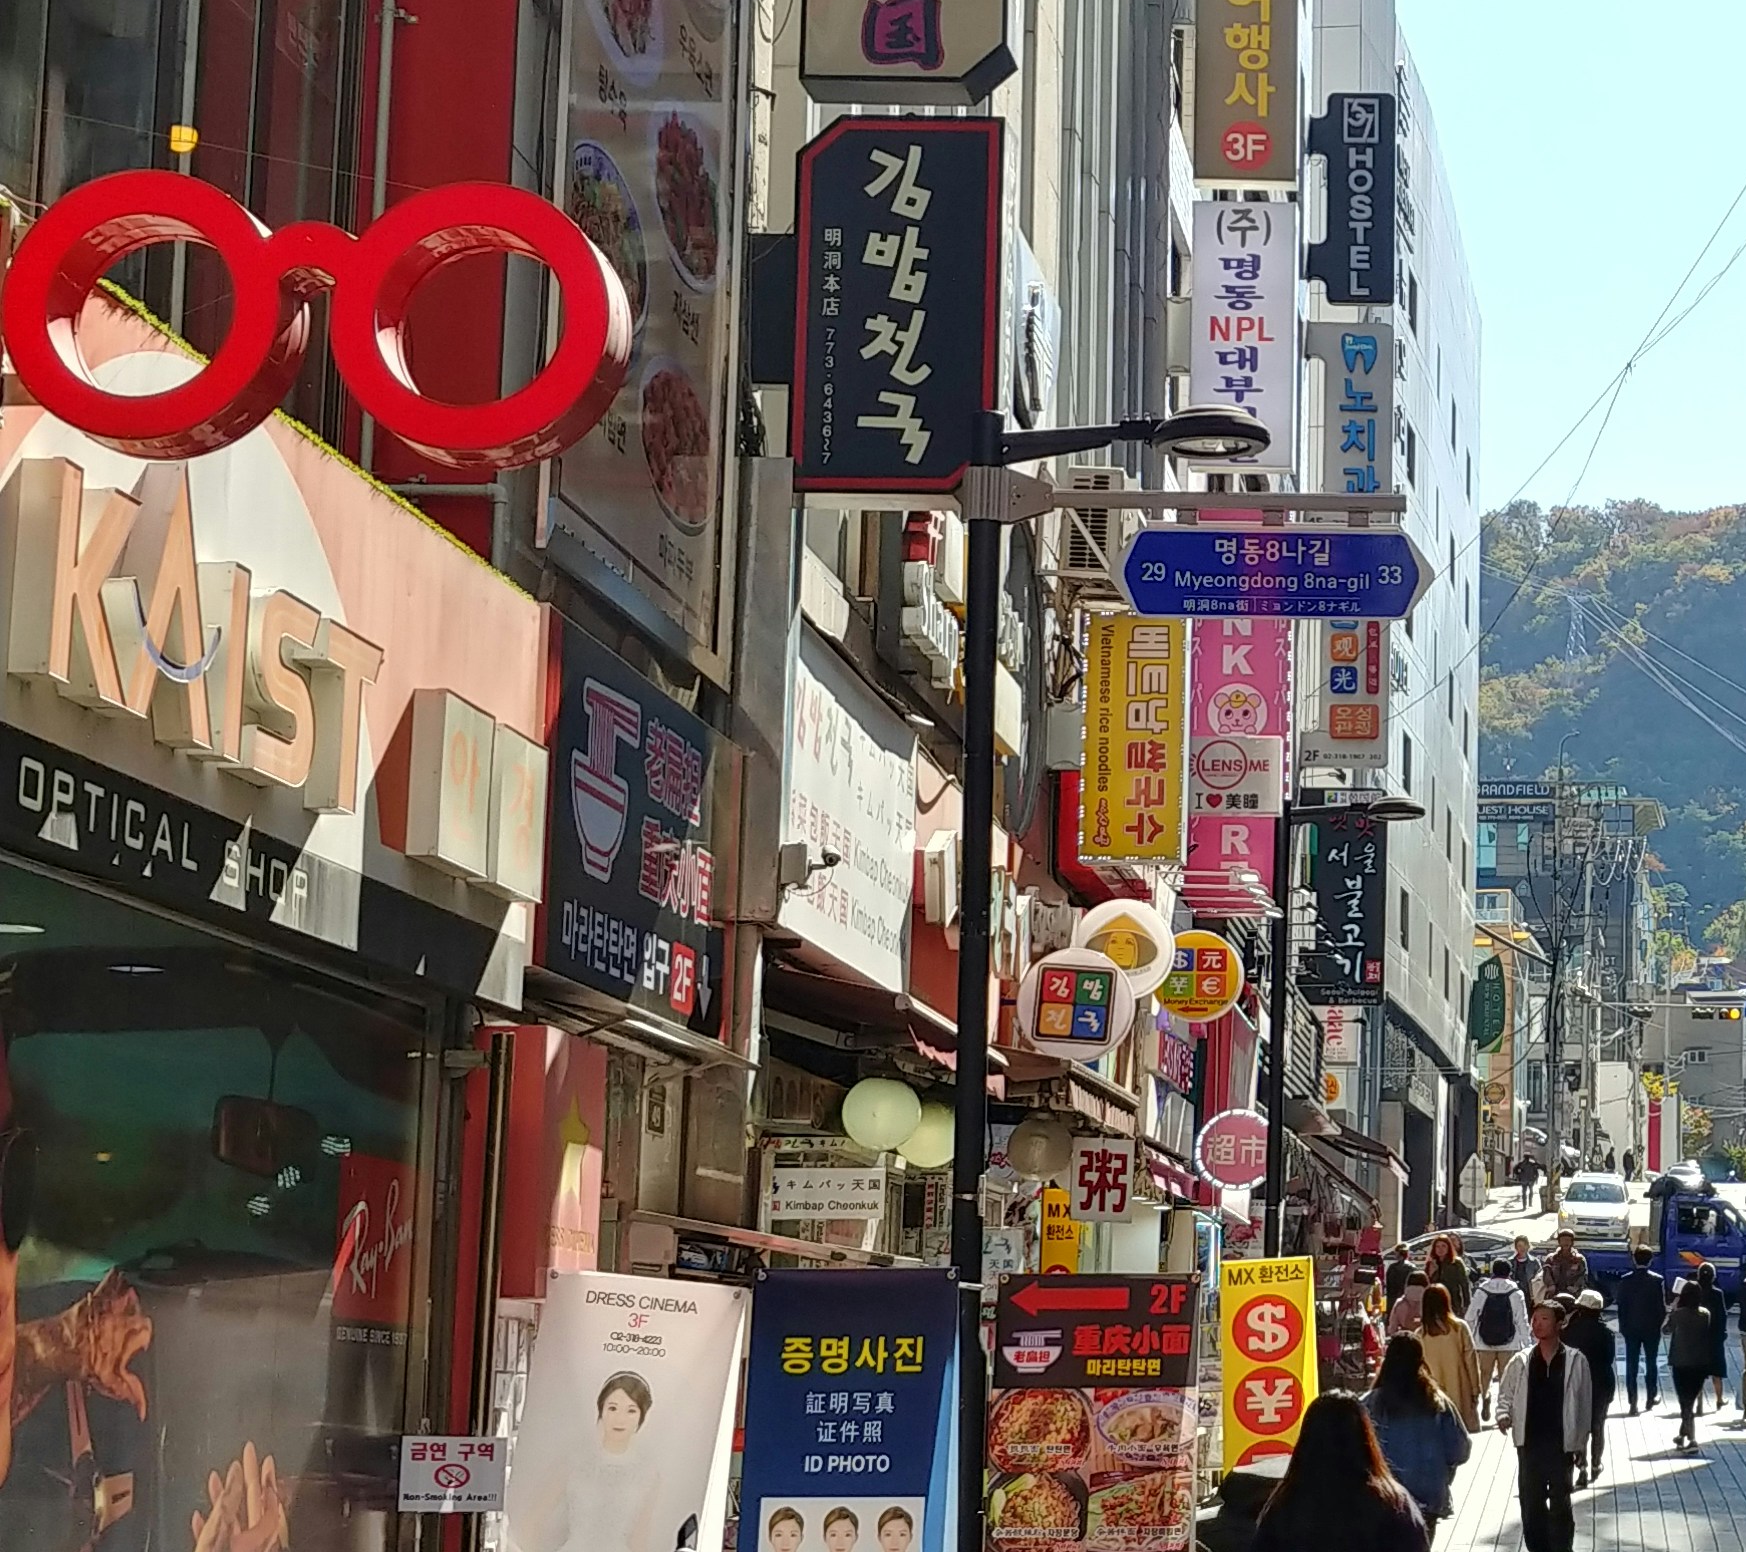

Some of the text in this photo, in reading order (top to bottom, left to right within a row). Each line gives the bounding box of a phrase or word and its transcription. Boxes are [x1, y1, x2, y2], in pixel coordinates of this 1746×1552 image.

[1224, 133, 1267, 161] 3F
[1348, 148, 1374, 296] HOSTEL
[821, 228, 842, 317] 明洞本店
[856, 145, 932, 464] 김밥천국
[1209, 316, 1274, 342] NPL
[1214, 538, 1331, 566] 명동8나길
[1141, 563, 1166, 582] 29
[1175, 570, 1371, 591] Myeongdong 8na-gil
[1377, 565, 1402, 585] 33
[10, 456, 384, 815] KAIST
[1101, 625, 1114, 702] Vietnamese
[1100, 707, 1111, 734] rice
[1123, 624, 1170, 846] 베트남 쌀국수
[1097, 737, 1110, 793] noodles
[1201, 759, 1269, 772] LENS ME
[1304, 750, 1319, 761] 2F
[1477, 805, 1548, 815] UEST HOUSE
[19, 757, 309, 908] OPTICAL SHOP
[673, 951, 693, 1003] 2F
[785, 1200, 825, 1212] Kimbap
[1228, 1264, 1305, 1286] MX 환전소
[586, 1290, 698, 1314] DRESS CINEMA
[1150, 1285, 1187, 1315] 2F
[628, 1313, 650, 1328] 3F
[1072, 1325, 1191, 1355] 重庆小面
[781, 1336, 924, 1375] 증명사진
[804, 1392, 896, 1415] 証明写真
[816, 1420, 883, 1443] 证件照
[410, 1443, 494, 1462] 금연 구역
[804, 1452, 890, 1474] ID PHOTO
